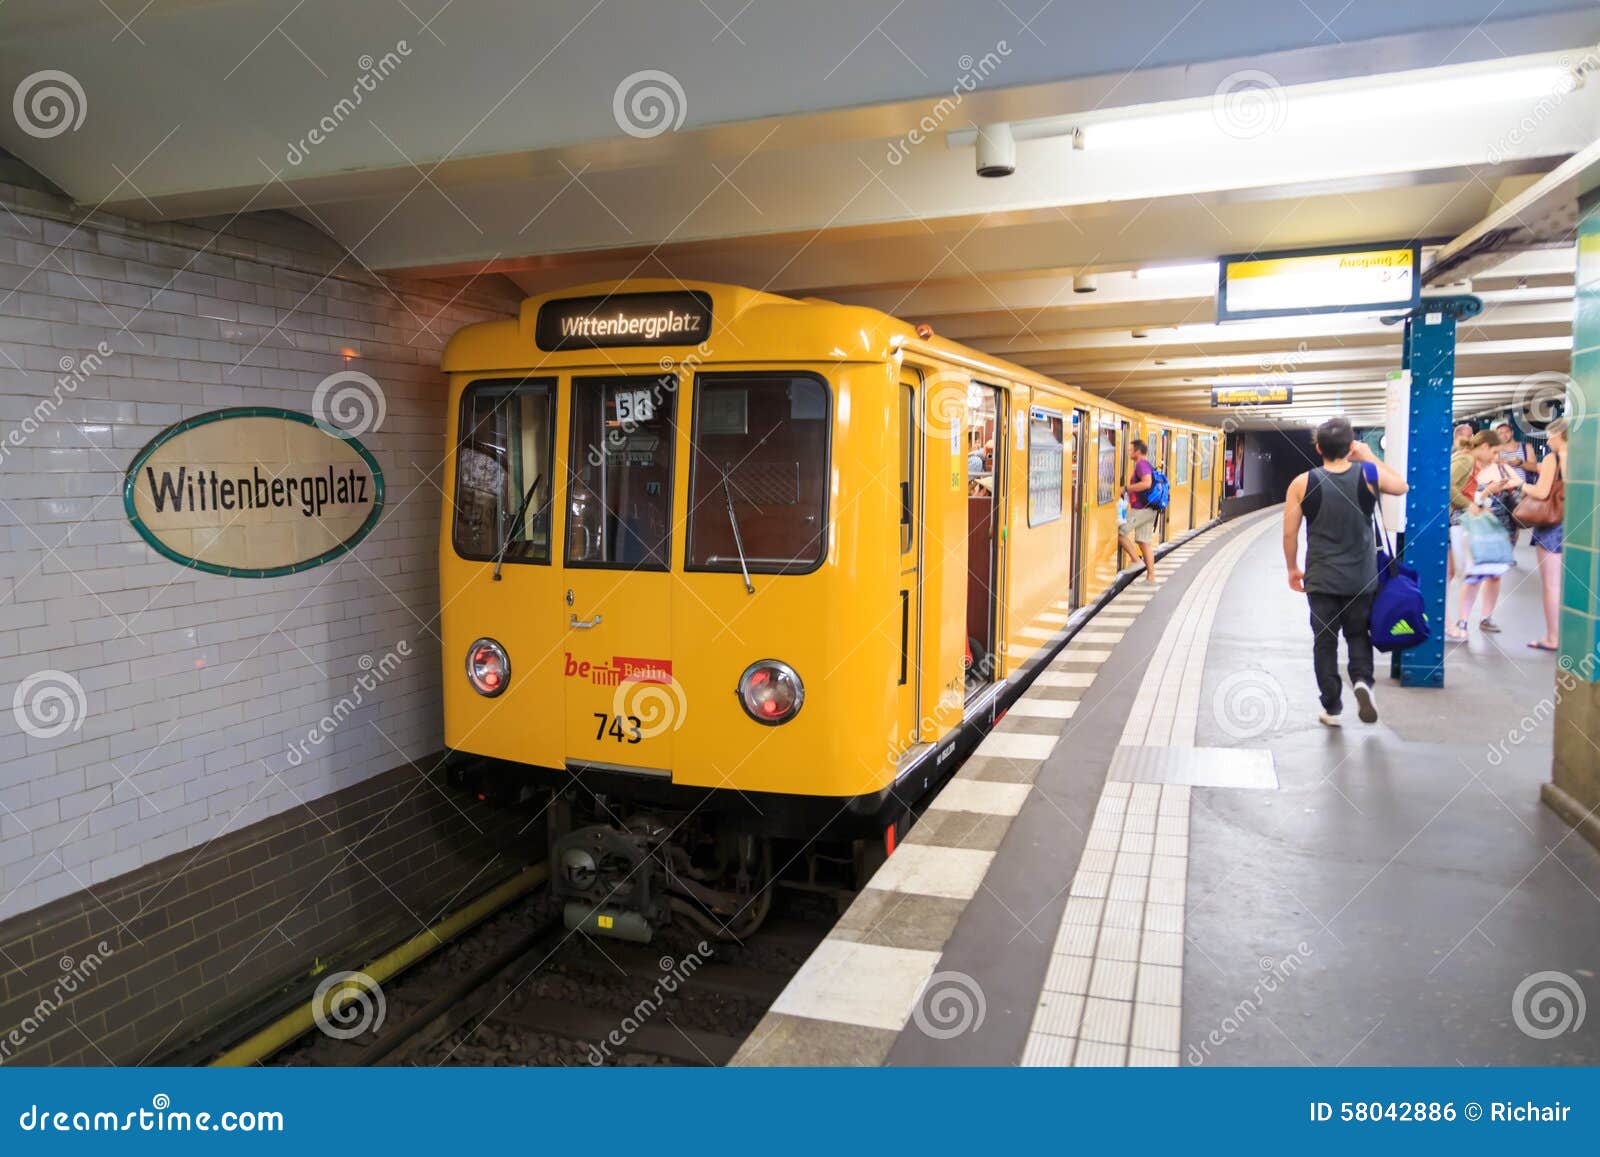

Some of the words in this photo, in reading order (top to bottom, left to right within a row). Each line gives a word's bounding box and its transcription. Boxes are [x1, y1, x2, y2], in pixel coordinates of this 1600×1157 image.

[561, 310, 701, 338] Wittenbergplatz
[146, 465, 369, 517] Wittenbergplatz
[623, 663, 667, 680] Berlin
[593, 712, 642, 744] 743
